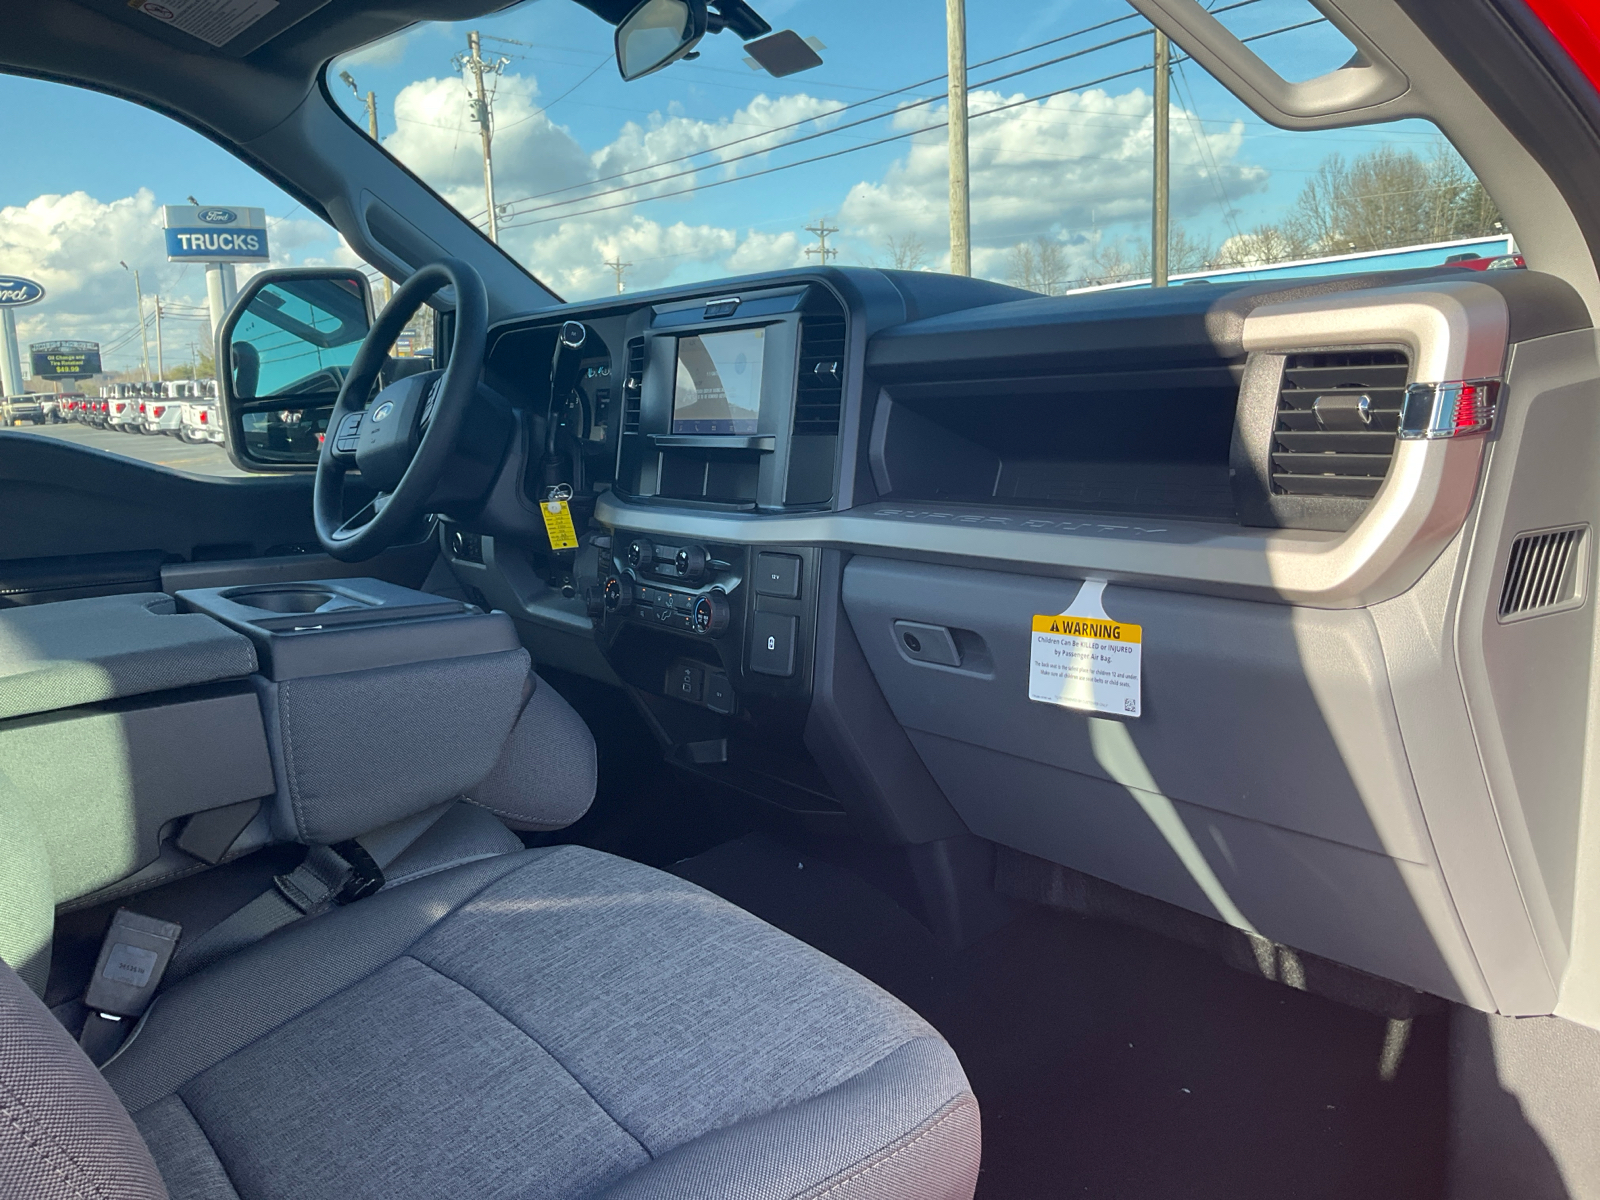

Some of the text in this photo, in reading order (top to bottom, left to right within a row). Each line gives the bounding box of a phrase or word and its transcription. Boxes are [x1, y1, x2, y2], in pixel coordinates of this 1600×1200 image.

[206, 210, 228, 221] Ford
[177, 233, 260, 251] TRUCKS
[874, 509, 1168, 535] SUPER DUTY
[1062, 620, 1121, 640] WARNING
[1037, 636, 1060, 645] Children
[1061, 638, 1072, 646] Can
[1080, 641, 1100, 650] KILLED
[1108, 644, 1133, 654] INJURED
[1054, 649, 1061, 658] by
[1062, 650, 1090, 661] Passenger
